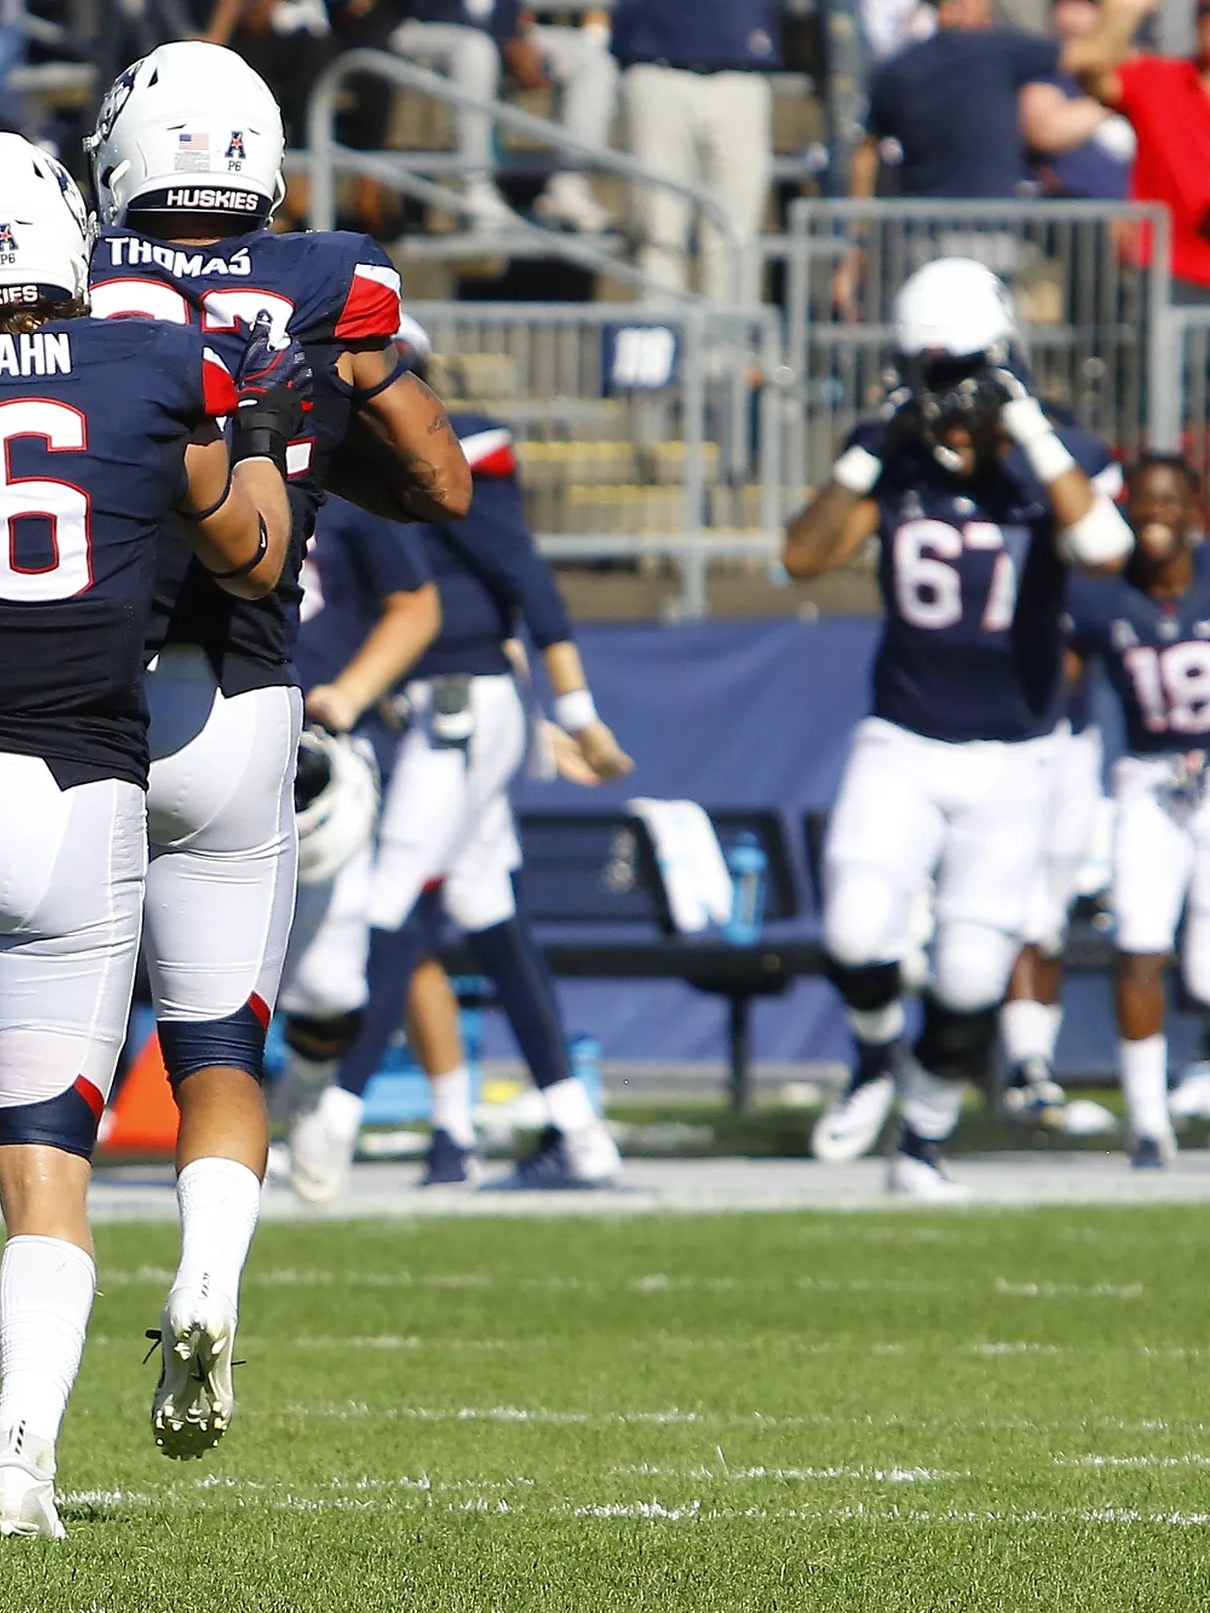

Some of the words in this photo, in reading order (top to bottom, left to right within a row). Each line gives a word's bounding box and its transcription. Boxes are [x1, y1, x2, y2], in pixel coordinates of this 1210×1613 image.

[228, 160, 242, 171] P6
[167, 189, 259, 211] HUSKIES
[0, 253, 16, 265] P6
[104, 236, 252, 279] THOMAS
[893, 518, 1030, 634] 67
